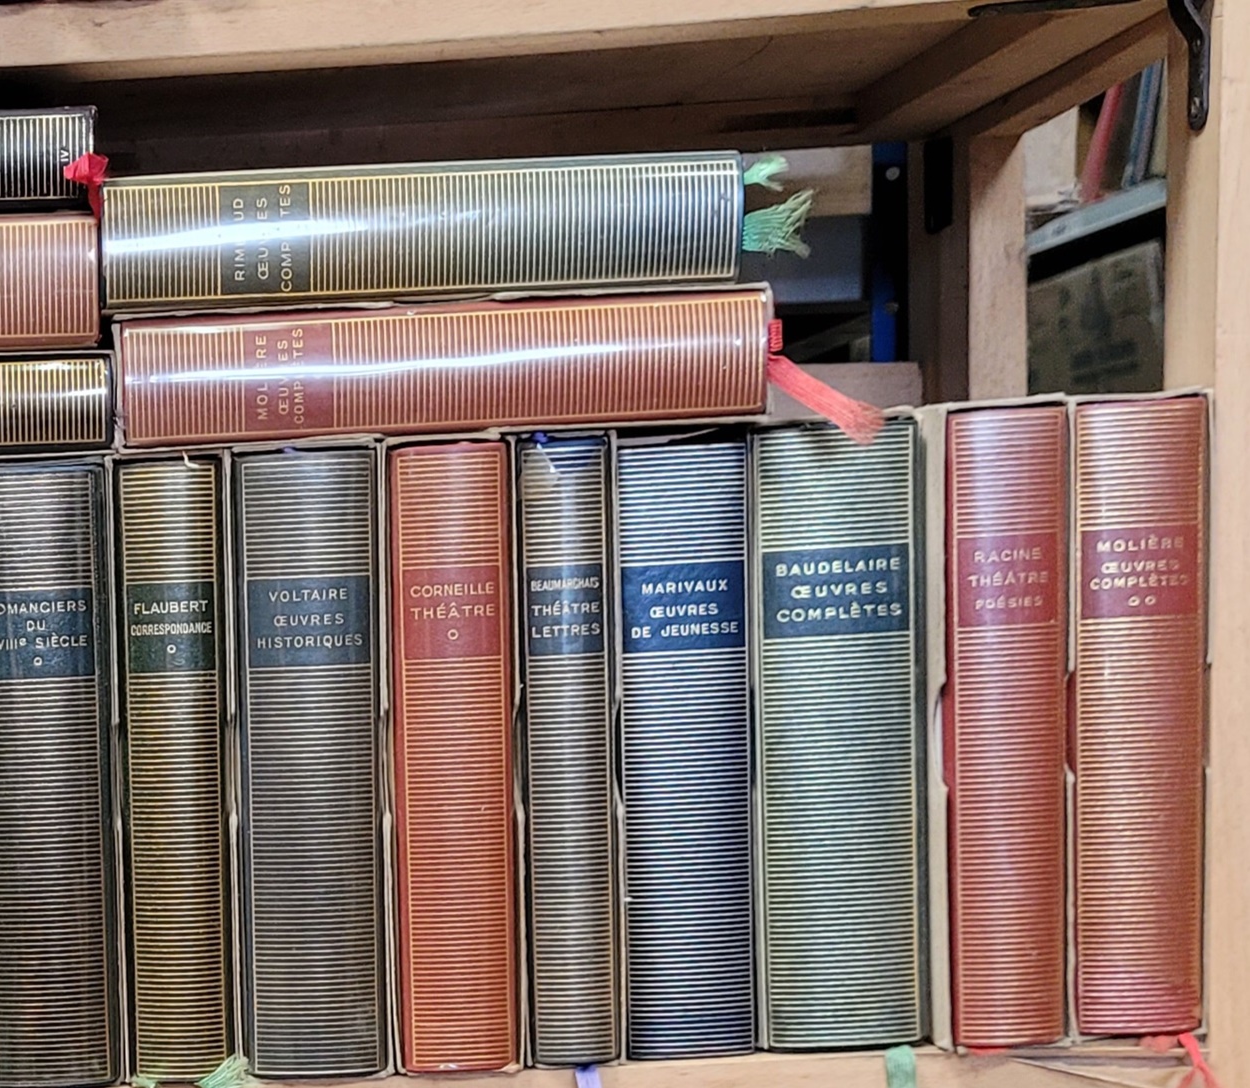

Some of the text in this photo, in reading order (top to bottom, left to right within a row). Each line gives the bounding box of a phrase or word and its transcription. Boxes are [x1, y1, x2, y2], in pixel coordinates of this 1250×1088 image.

[1096, 534, 1184, 553] MOLIÈRE
[974, 547, 1043, 563] RACINE
[775, 557, 900, 577] BAUDELAIRE
[1101, 559, 1180, 574] ŒUVRES
[530, 576, 600, 592] BEAUMARCHAIS
[642, 579, 728, 595] MARIVAUX
[967, 570, 1049, 588] THÉÂTRE
[1090, 573, 1188, 590] COMPLÈTES
[268, 588, 348, 602] VOLTAIRE
[410, 581, 495, 598] CORNEILLE
[791, 582, 888, 599] ŒUVRES
[134, 600, 208, 615] FLAUBERT
[531, 601, 600, 617] THÉÂTRE
[650, 603, 719, 618] ŒUVRES
[975, 595, 1043, 610] POÉSIES
[410, 602, 496, 620] THÉÂTRE
[776, 601, 902, 623] COMPLÈTES
[26, 620, 46, 632] DU
[274, 613, 345, 627] ŒUVRES
[131, 621, 213, 636] CORRESPONDANCE
[531, 622, 601, 638] LETTRES
[631, 621, 739, 639] DE JEUNESSE
[35, 632, 88, 649] SIÈCLE
[257, 633, 363, 649] HISTORIQUES
